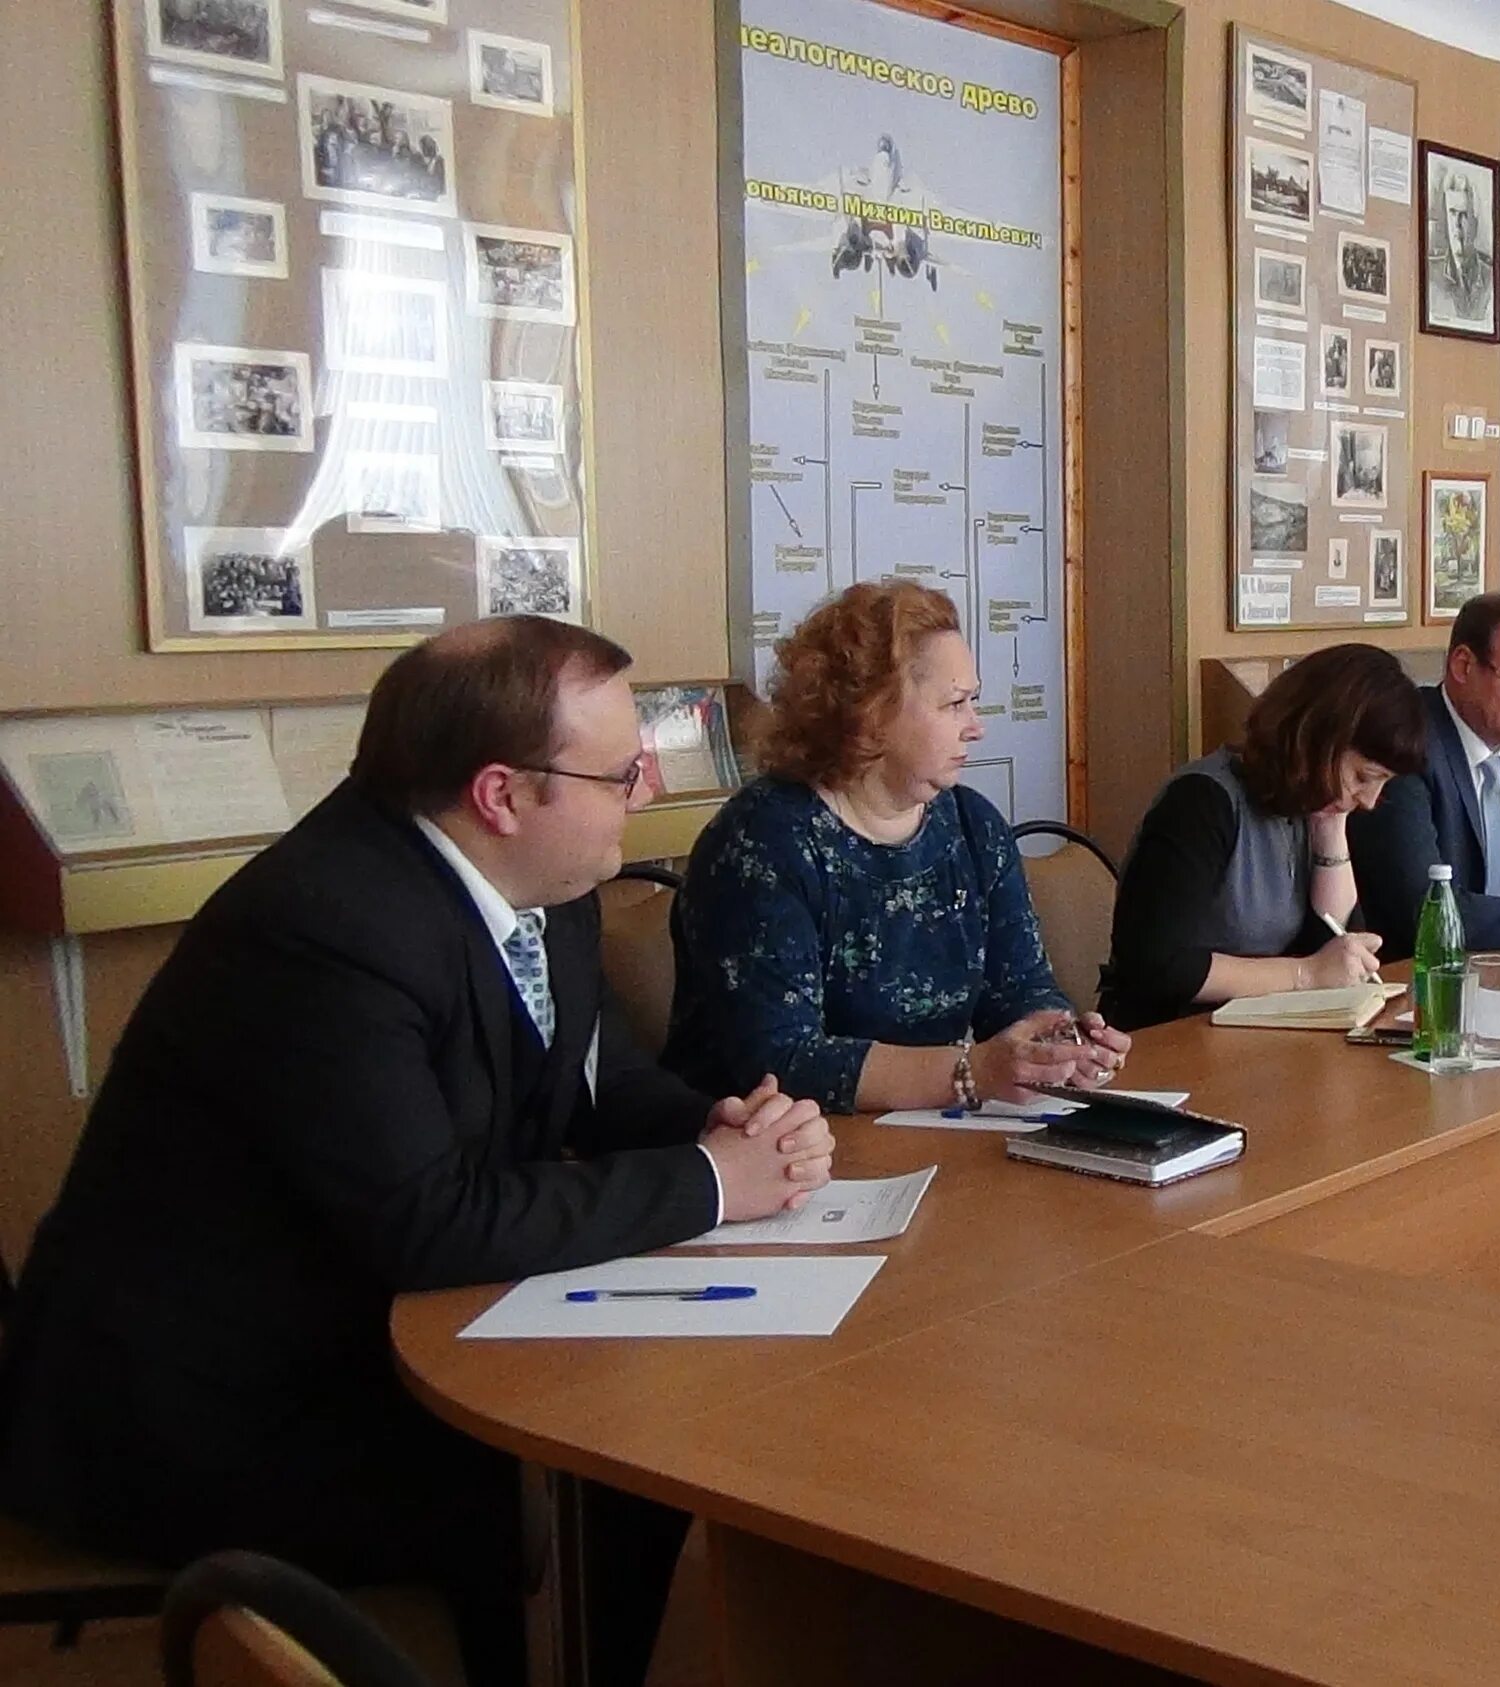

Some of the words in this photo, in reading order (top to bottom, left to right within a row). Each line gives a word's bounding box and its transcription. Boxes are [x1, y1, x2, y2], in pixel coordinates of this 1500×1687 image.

[962, 82, 1038, 119] древо
[744, 179, 837, 212] опьянов
[843, 195, 924, 228] Михаил
[929, 209, 1041, 249] Васильевич
